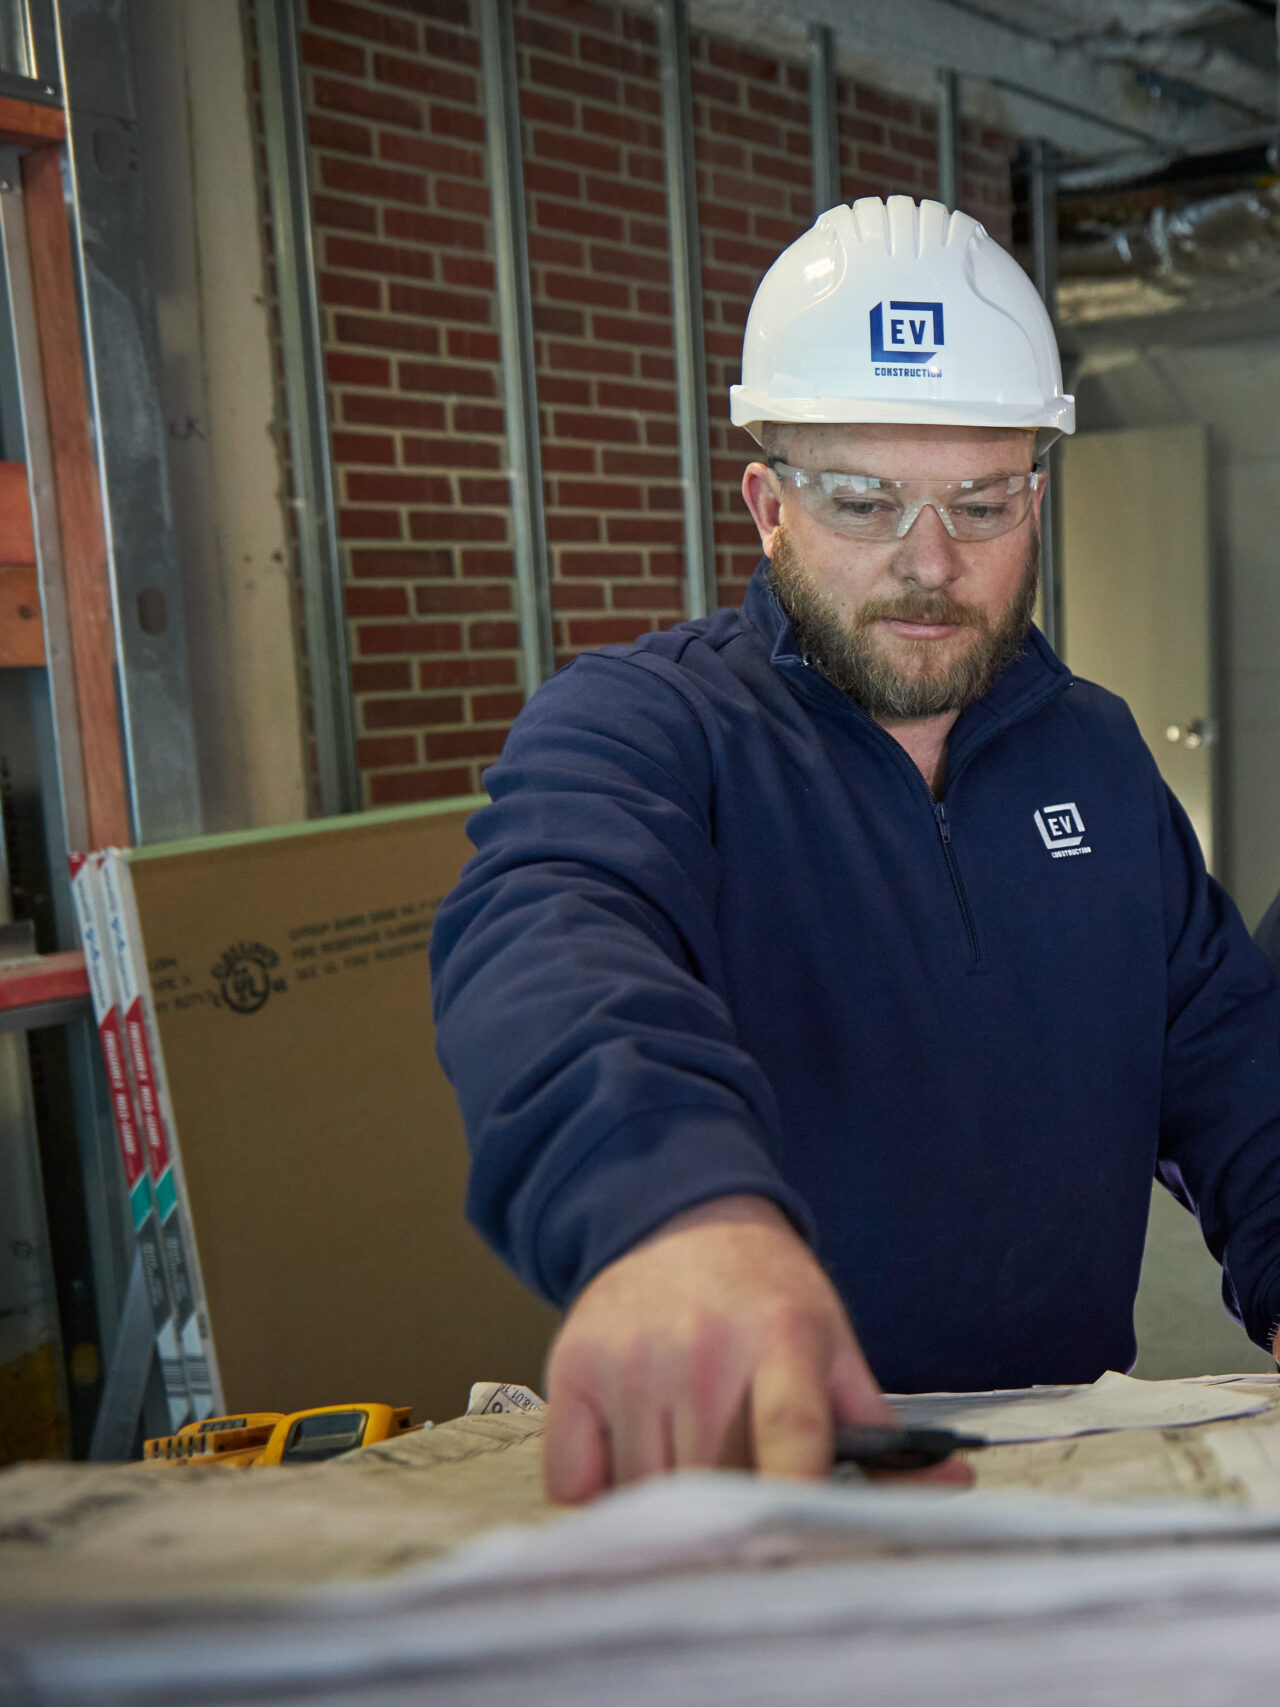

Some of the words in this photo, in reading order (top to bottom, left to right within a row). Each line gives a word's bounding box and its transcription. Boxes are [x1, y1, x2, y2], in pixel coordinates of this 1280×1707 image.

[891, 319, 926, 345] EV
[874, 367, 943, 378] CONSTRUCTION
[1048, 815, 1073, 836] EV
[1051, 846, 1092, 858] CONSTRUCTION
